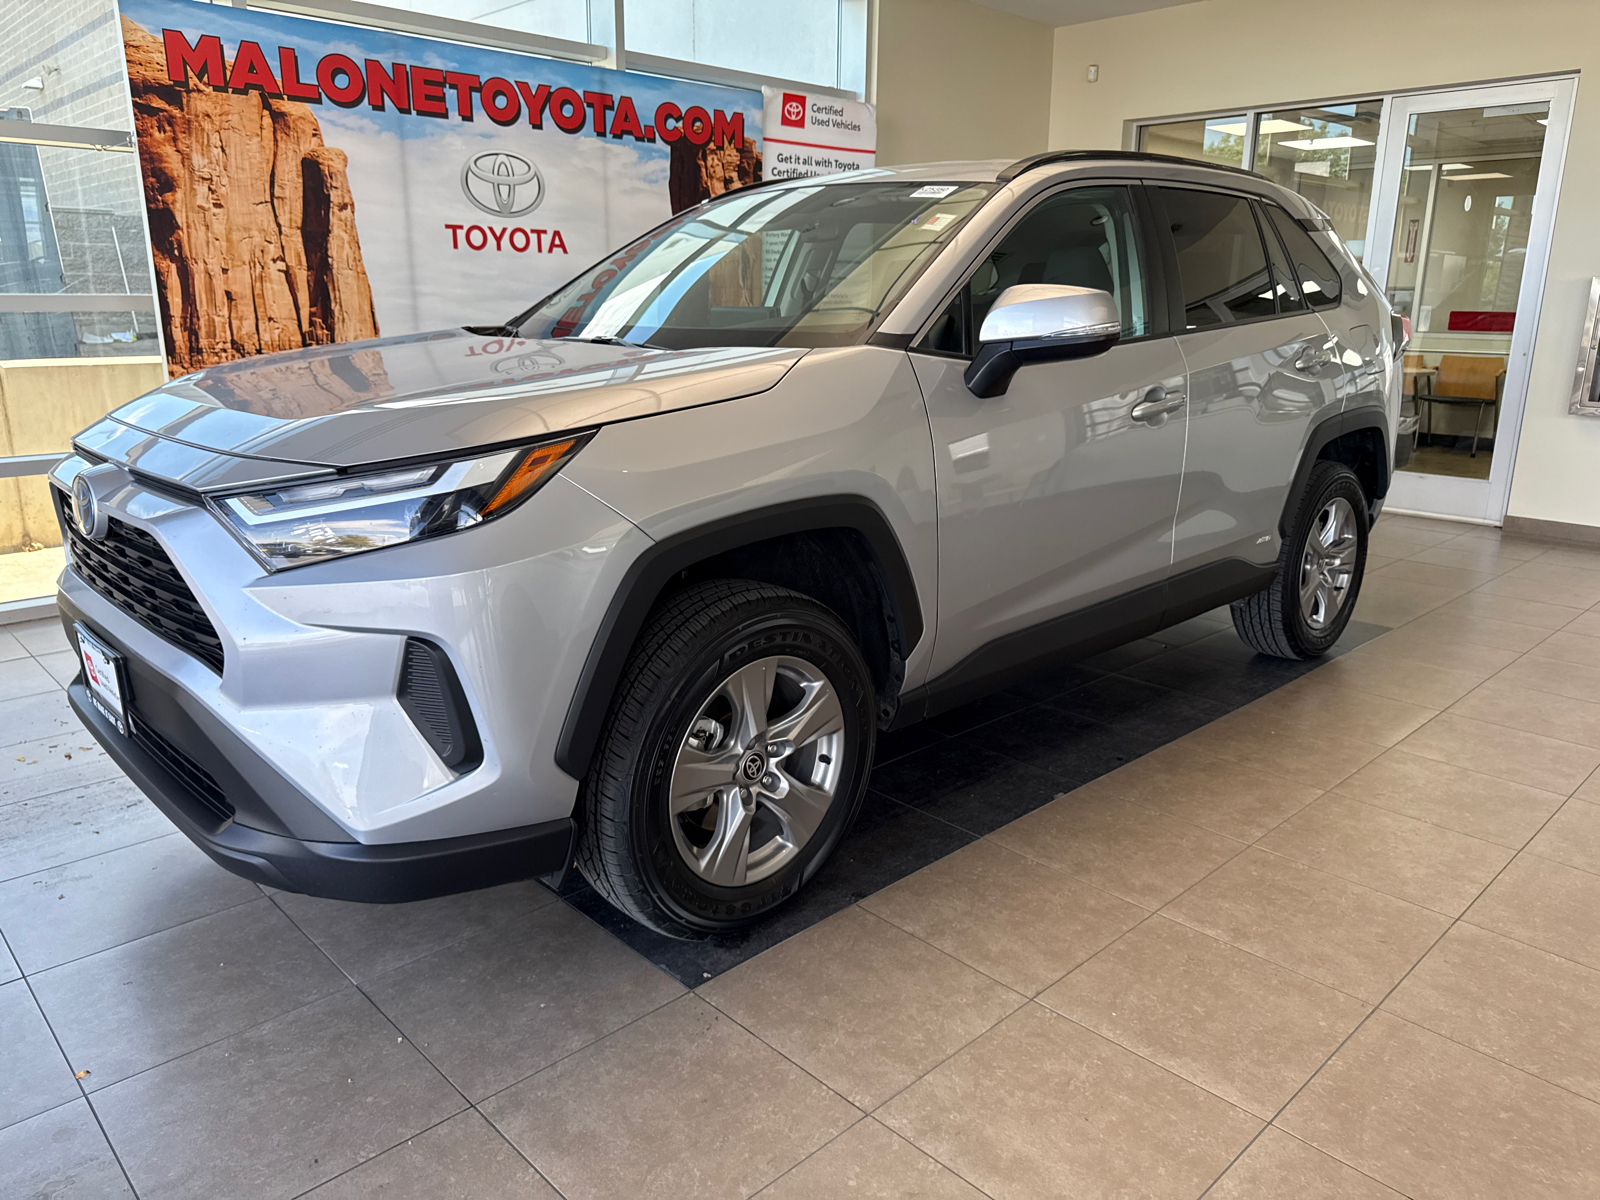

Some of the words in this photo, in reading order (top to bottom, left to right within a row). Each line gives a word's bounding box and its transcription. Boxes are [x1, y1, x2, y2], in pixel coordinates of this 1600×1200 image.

[162, 28, 745, 149] MALONETOYOTA.COM
[811, 103, 844, 117] Certified
[811, 116, 830, 127] Used
[832, 119, 861, 132] Vehicles
[776, 153, 792, 164] Get
[794, 154, 801, 165] it
[802, 156, 813, 166] all
[815, 157, 832, 169] with
[834, 159, 860, 172] Toyota
[771, 167, 808, 178] Certified
[444, 223, 569, 255] TOYOTA
[727, 631, 861, 691] DESTINATION
